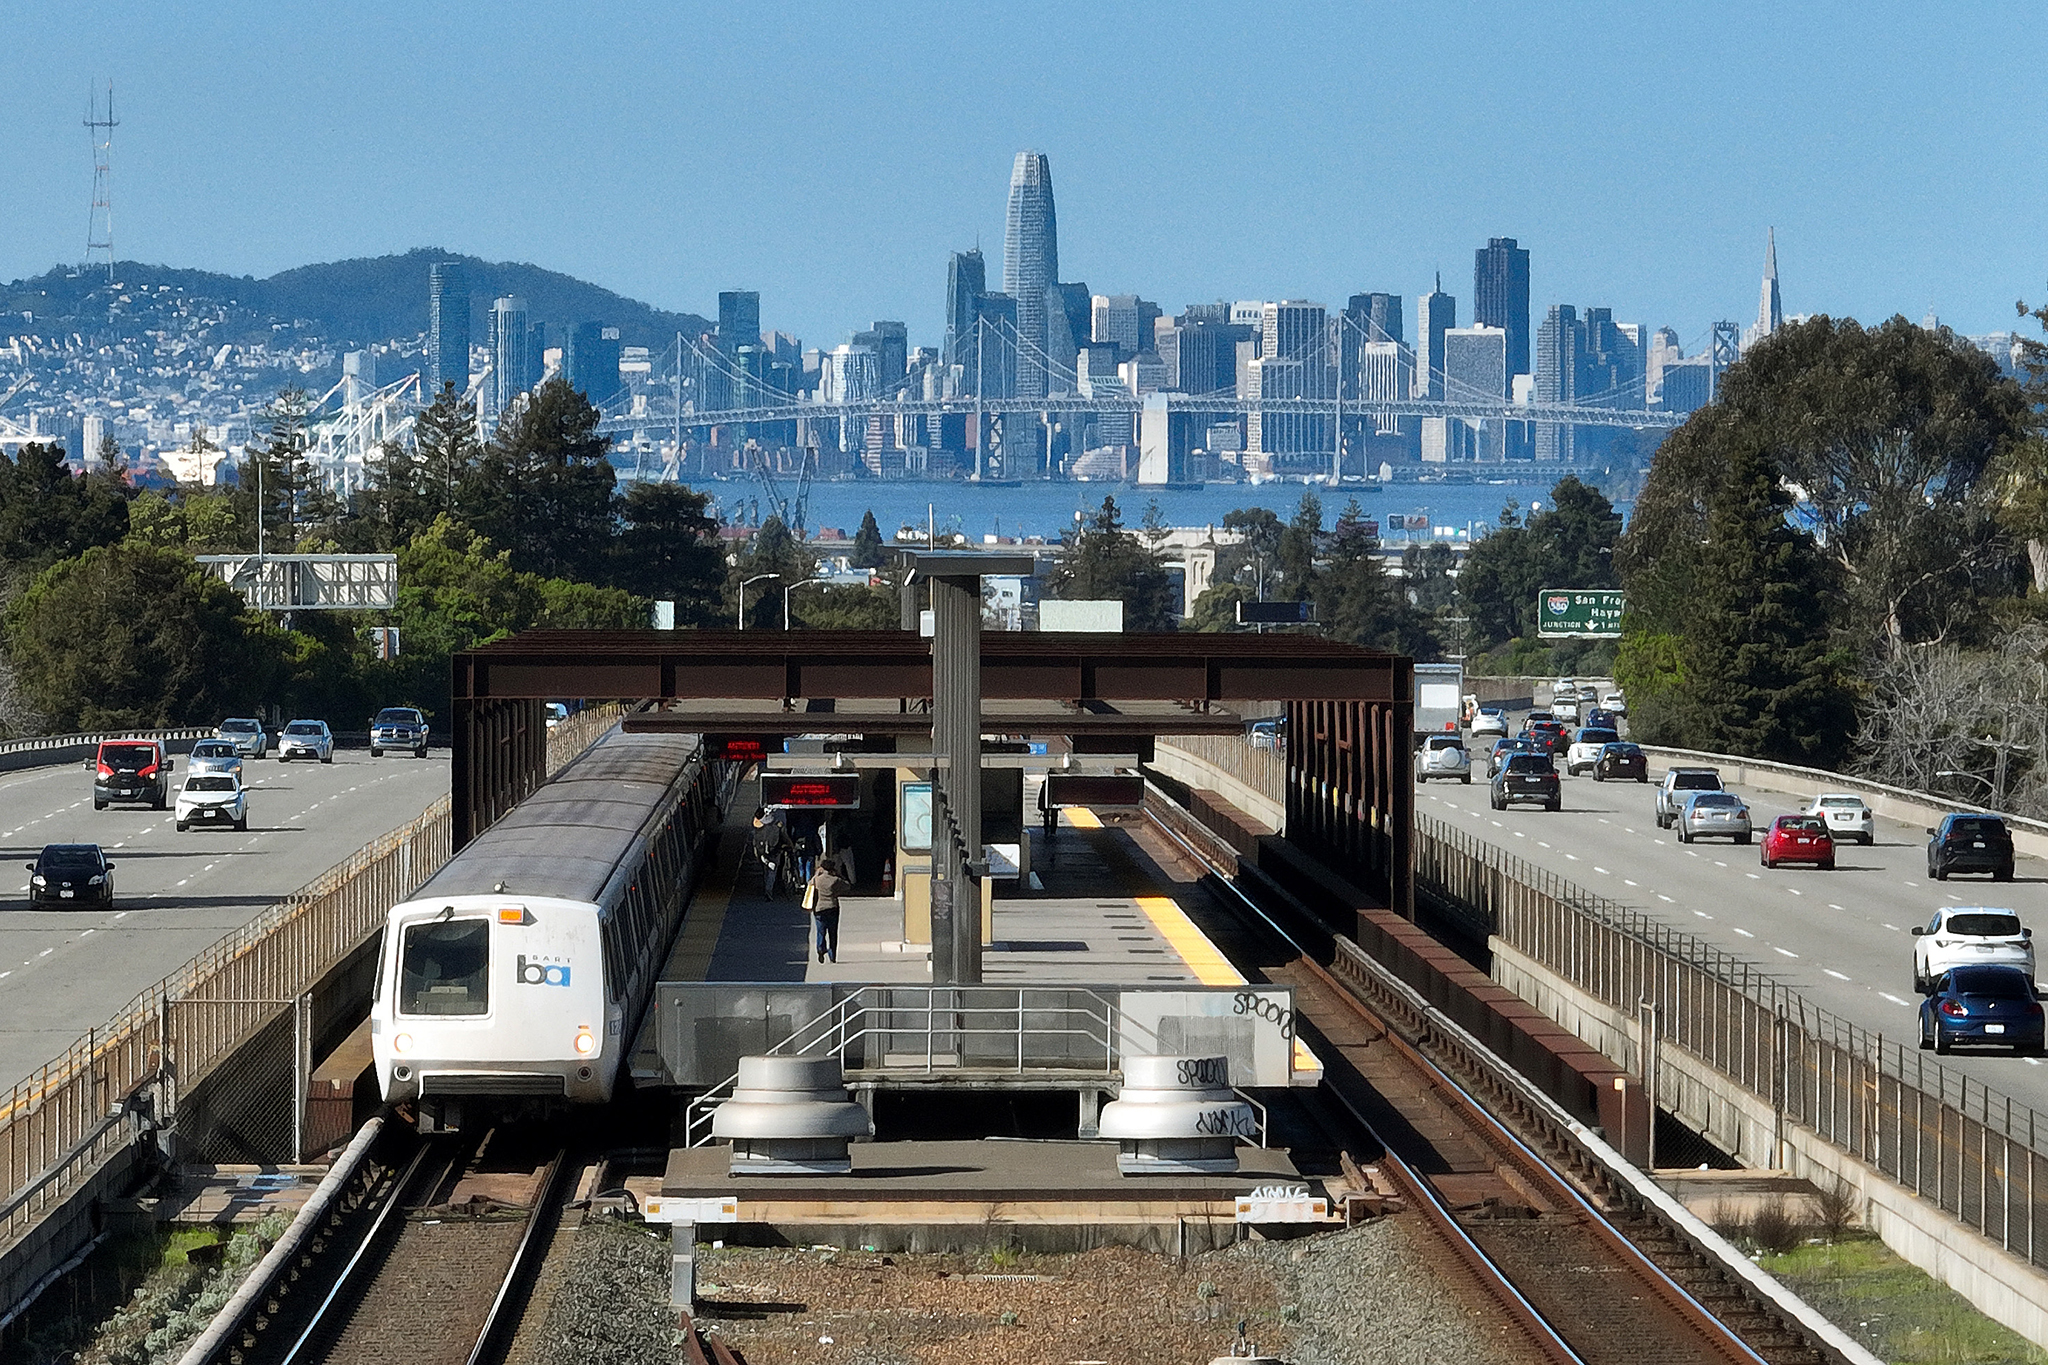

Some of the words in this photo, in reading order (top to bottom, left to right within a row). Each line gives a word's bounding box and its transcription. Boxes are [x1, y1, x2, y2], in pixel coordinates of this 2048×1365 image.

[1575, 595, 1596, 605] San
[1542, 621, 1581, 629] JUNCTION
[1601, 621, 1606, 629] 1
[532, 954, 571, 963] BART
